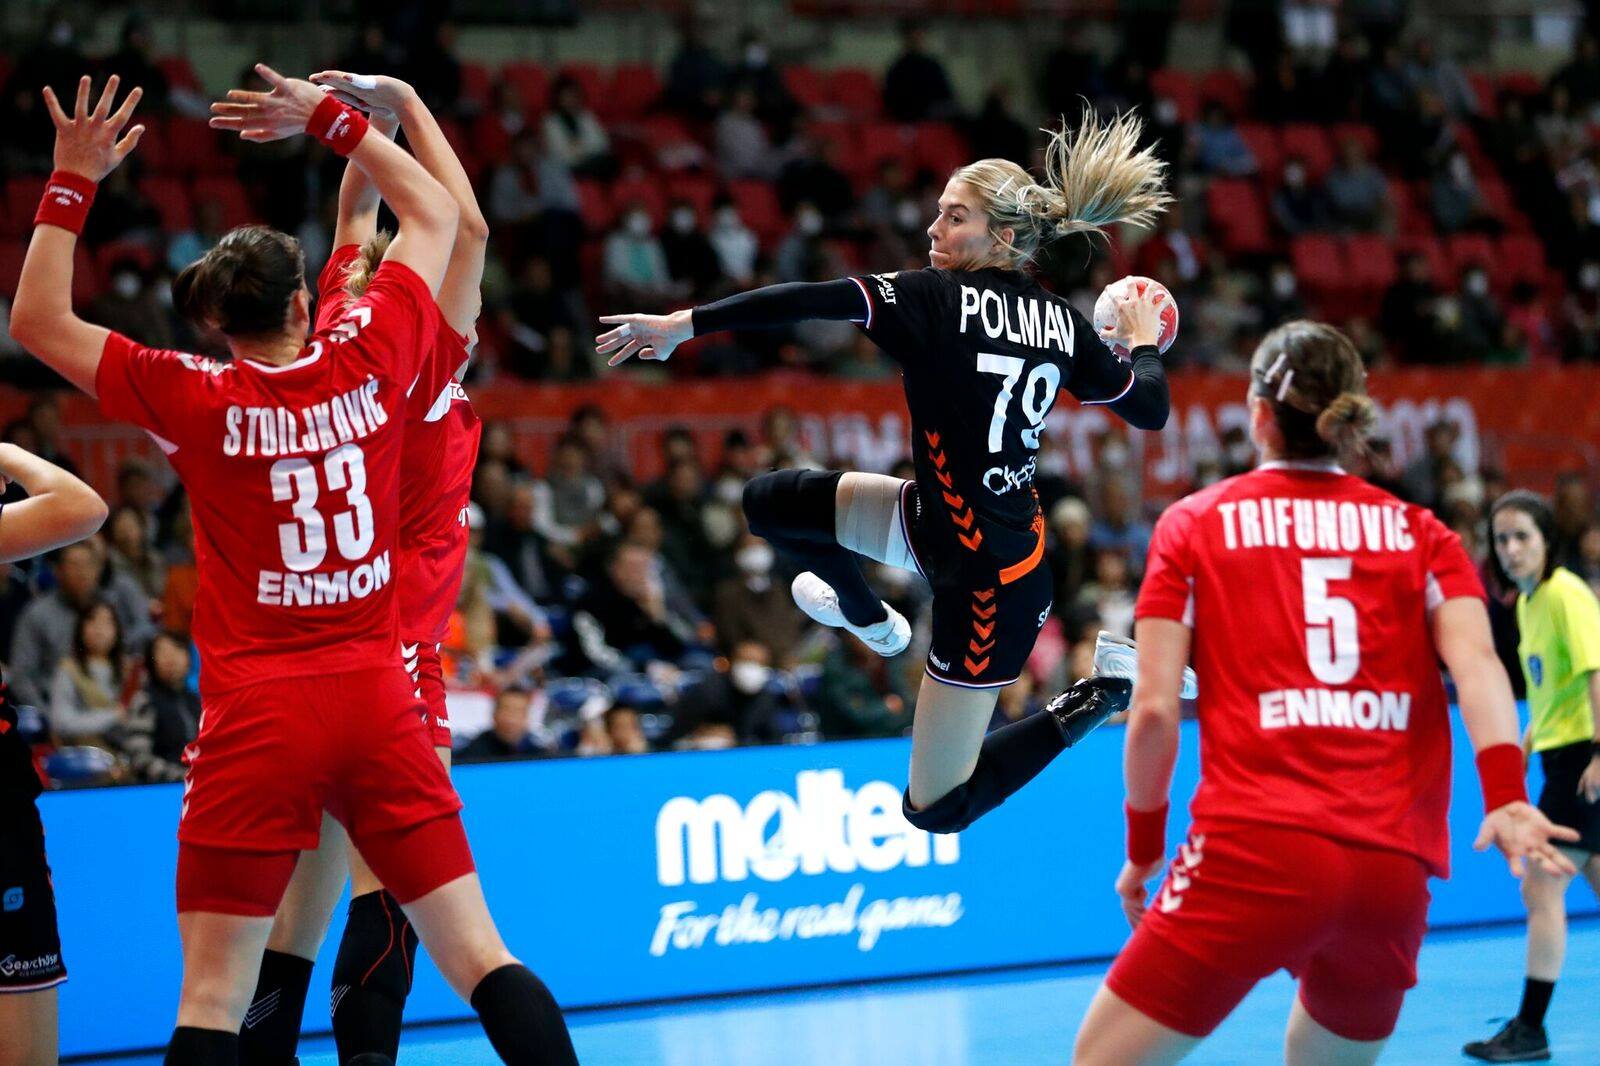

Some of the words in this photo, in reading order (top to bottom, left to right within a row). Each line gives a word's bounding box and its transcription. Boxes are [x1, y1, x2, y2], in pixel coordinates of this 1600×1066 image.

[960, 285, 1075, 357] POLMAN
[976, 352, 1060, 453] 79
[269, 442, 375, 572] 33
[257, 550, 391, 607] ENMON
[1301, 556, 1361, 686] 5
[1258, 687, 1412, 731] ENMON
[649, 900, 719, 956] For
[715, 892, 779, 946] the
[778, 883, 864, 941] real
[857, 891, 966, 952] game
